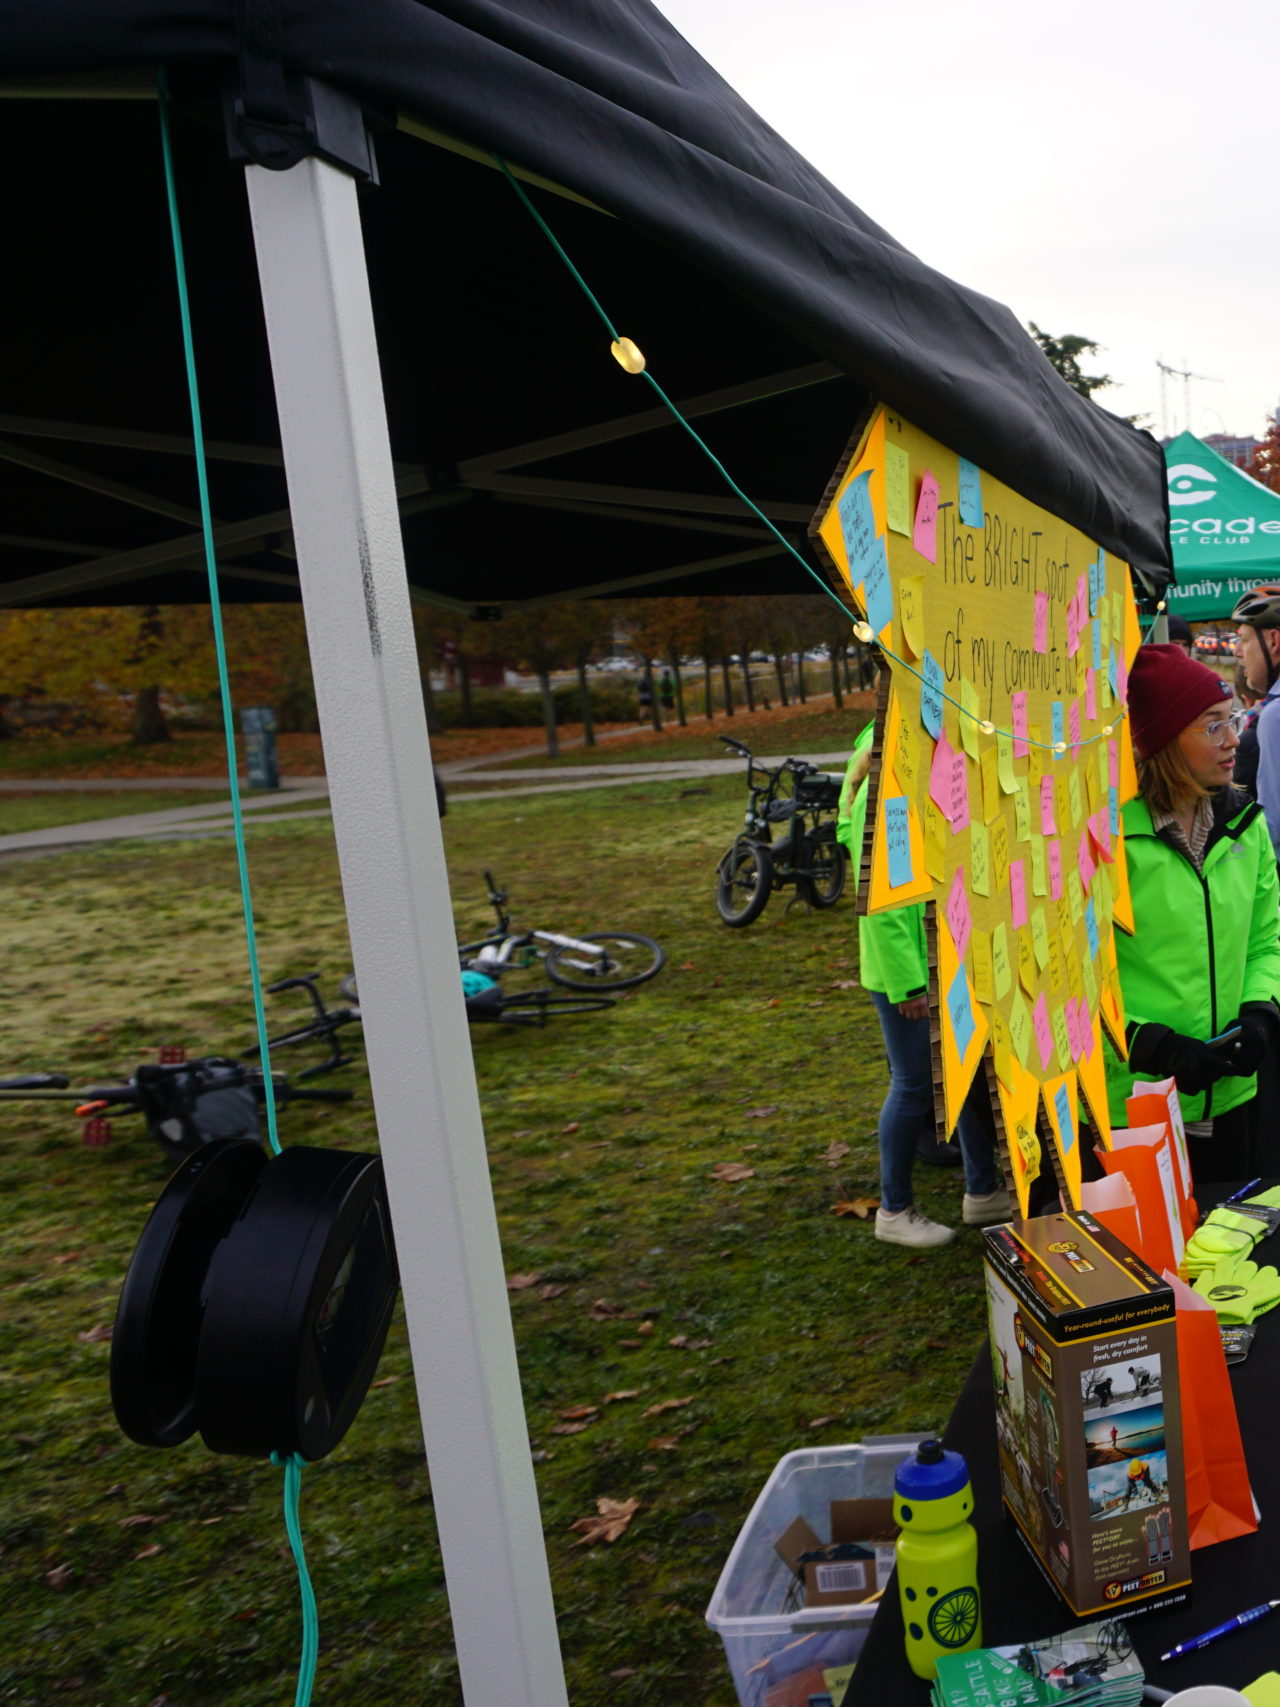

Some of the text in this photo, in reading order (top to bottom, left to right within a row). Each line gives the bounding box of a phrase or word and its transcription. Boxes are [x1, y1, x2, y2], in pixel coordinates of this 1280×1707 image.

[1200, 535, 1250, 545] CLUB
[938, 502, 976, 584] The
[984, 512, 1042, 593] BRIGHT
[1045, 536, 1070, 627] spot
[944, 608, 964, 682] of
[972, 637, 994, 721] my
[1064, 1303, 1171, 1333] Year-round-useful for everybody
[1093, 1343, 1110, 1353] Start
[1110, 1340, 1127, 1350] every
[1128, 1336, 1140, 1345] day
[1093, 1344, 1148, 1363] fresh, dry comfort
[1122, 1580, 1140, 1593] PEET
[1015, 1678, 1040, 1705] MAP
